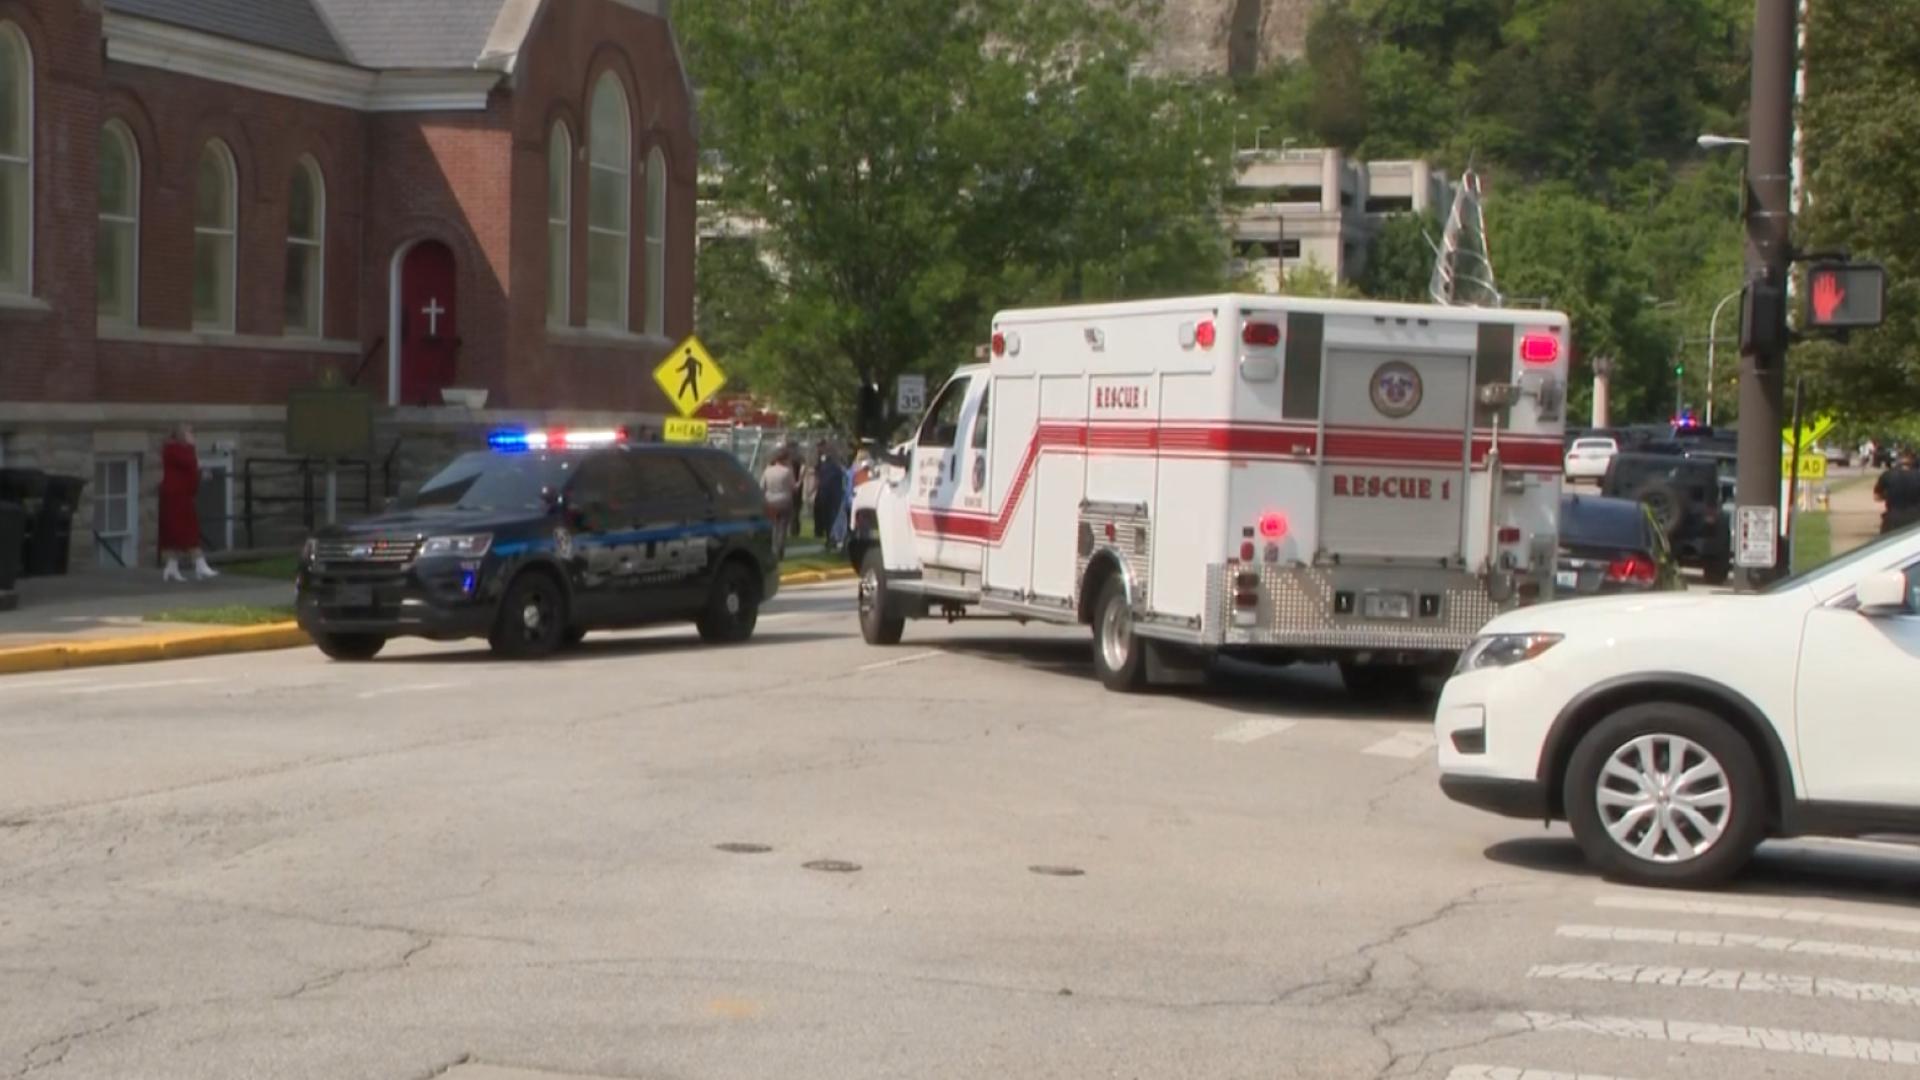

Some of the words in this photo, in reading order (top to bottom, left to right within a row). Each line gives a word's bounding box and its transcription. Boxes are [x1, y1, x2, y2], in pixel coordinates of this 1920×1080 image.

[901, 395, 922, 409] 35
[1096, 386, 1139, 408] RESCUE
[669, 423, 705, 438] AHEAD
[1334, 475, 1432, 499] RESCUE
[1442, 479, 1451, 500] 1
